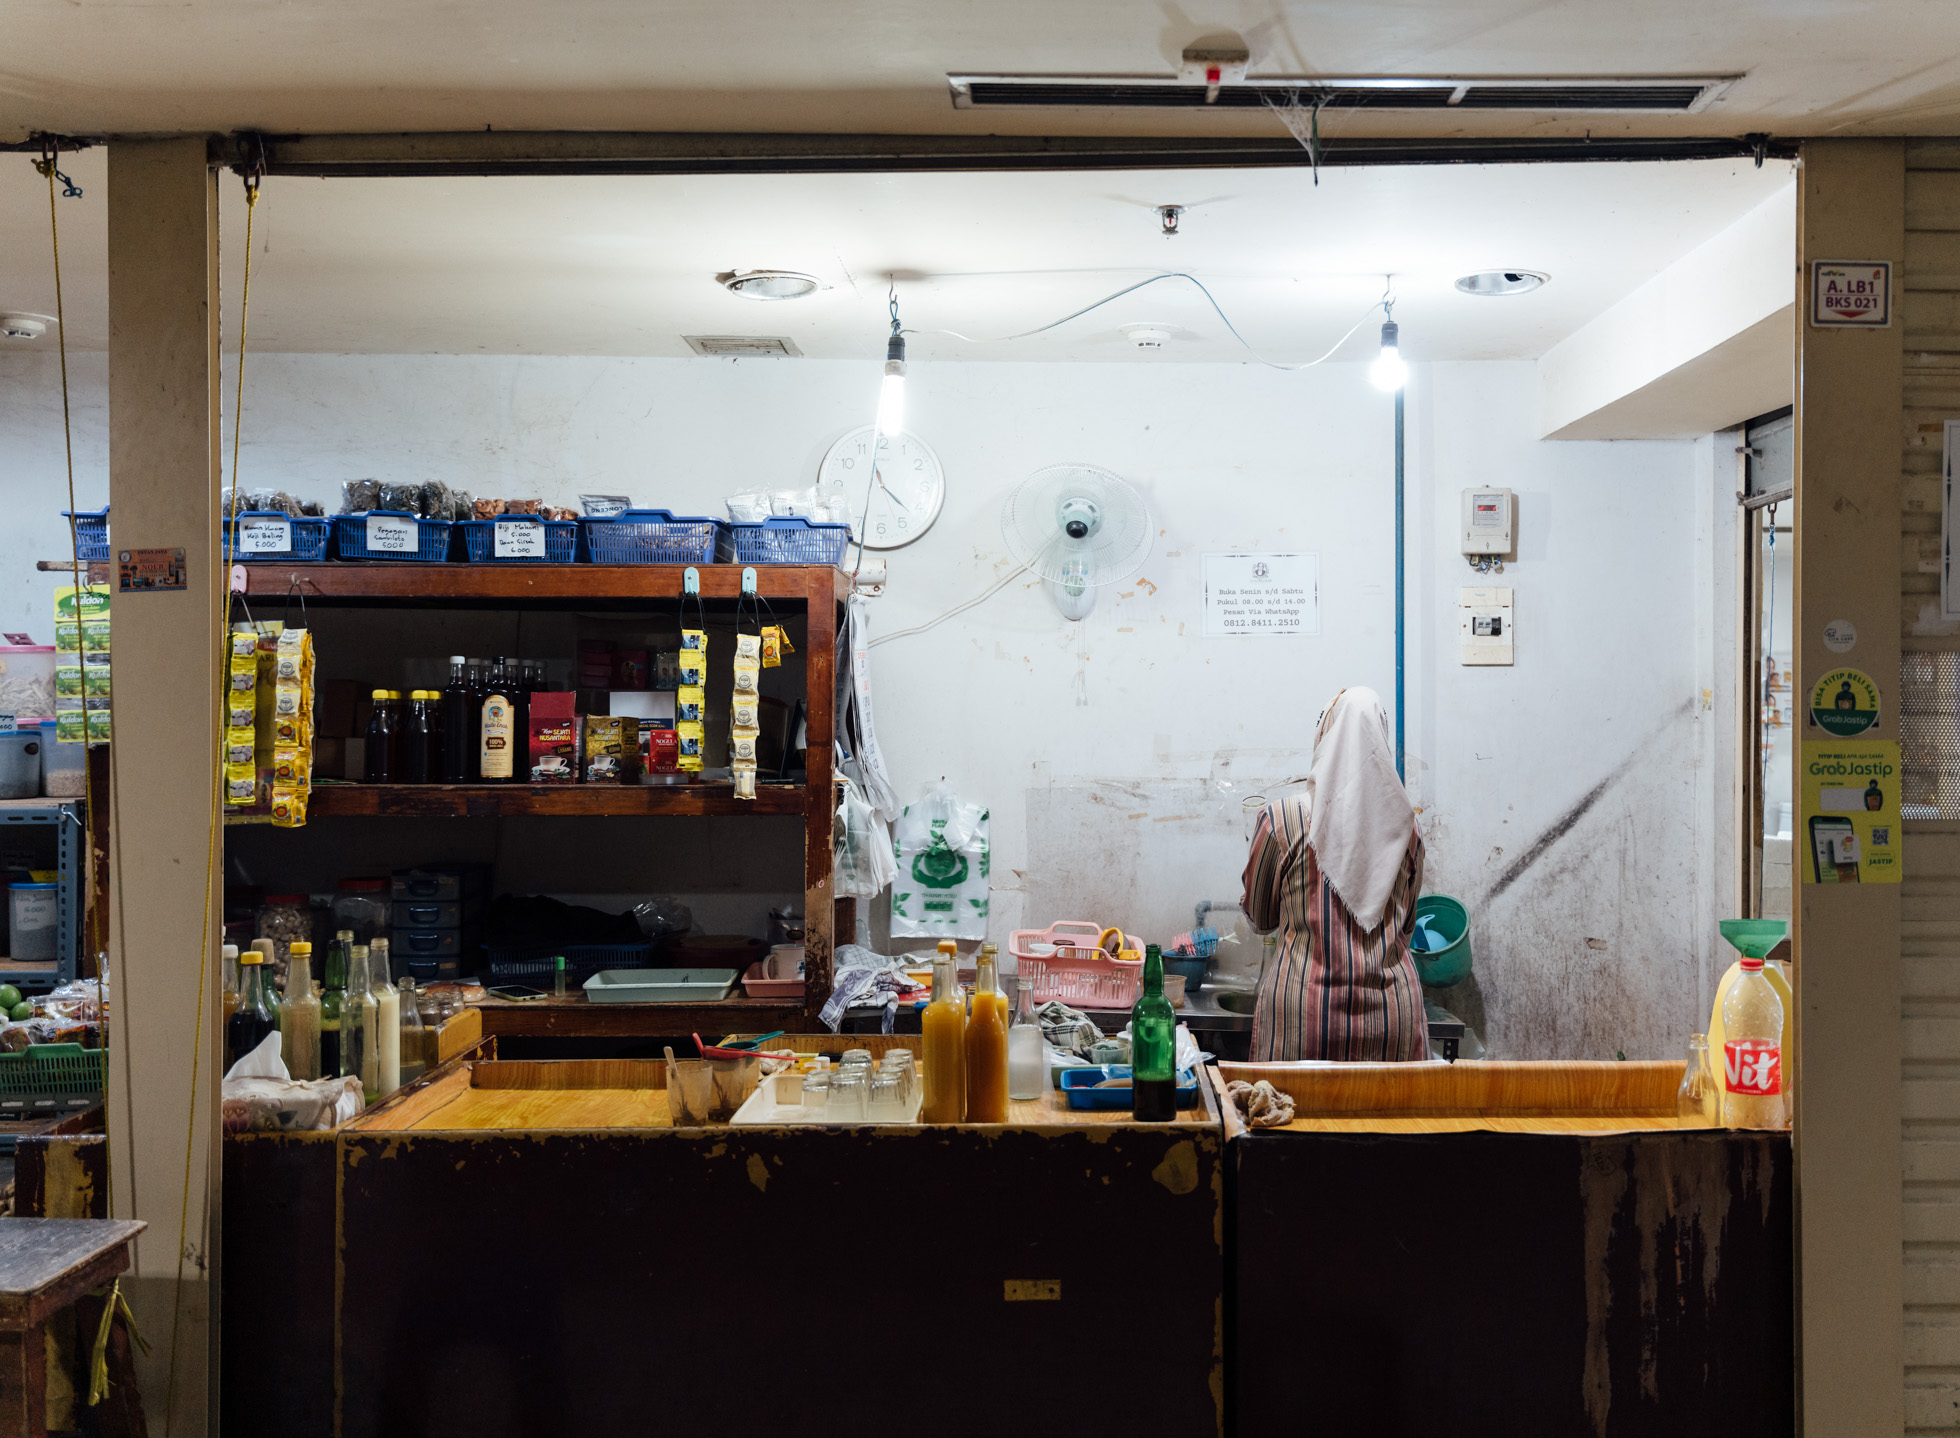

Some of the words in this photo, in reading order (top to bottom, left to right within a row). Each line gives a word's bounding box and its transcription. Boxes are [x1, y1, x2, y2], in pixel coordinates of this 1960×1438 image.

[1827, 280, 1843, 293] A.
[1847, 280, 1874, 294] LB1
[1826, 297, 1851, 308] BKS
[1854, 297, 1877, 309] 021
[842, 458, 855, 470] 10
[913, 459, 924, 471] 2
[876, 522, 887, 535] 6
[897, 516, 908, 529] 5
[1265, 588, 1278, 596] s/d
[1267, 598, 1280, 606] s/d
[1265, 608, 1300, 616] WhatsApp
[1223, 619, 1300, 627] 0812.8411.2510
[1815, 687, 1825, 706] BISA
[1823, 672, 1845, 686] TITIP
[1847, 672, 1865, 686] BELI
[1864, 684, 1876, 709] SAMA
[1869, 858, 1893, 866] JASTIP
[1724, 1047, 1778, 1090] Vit
